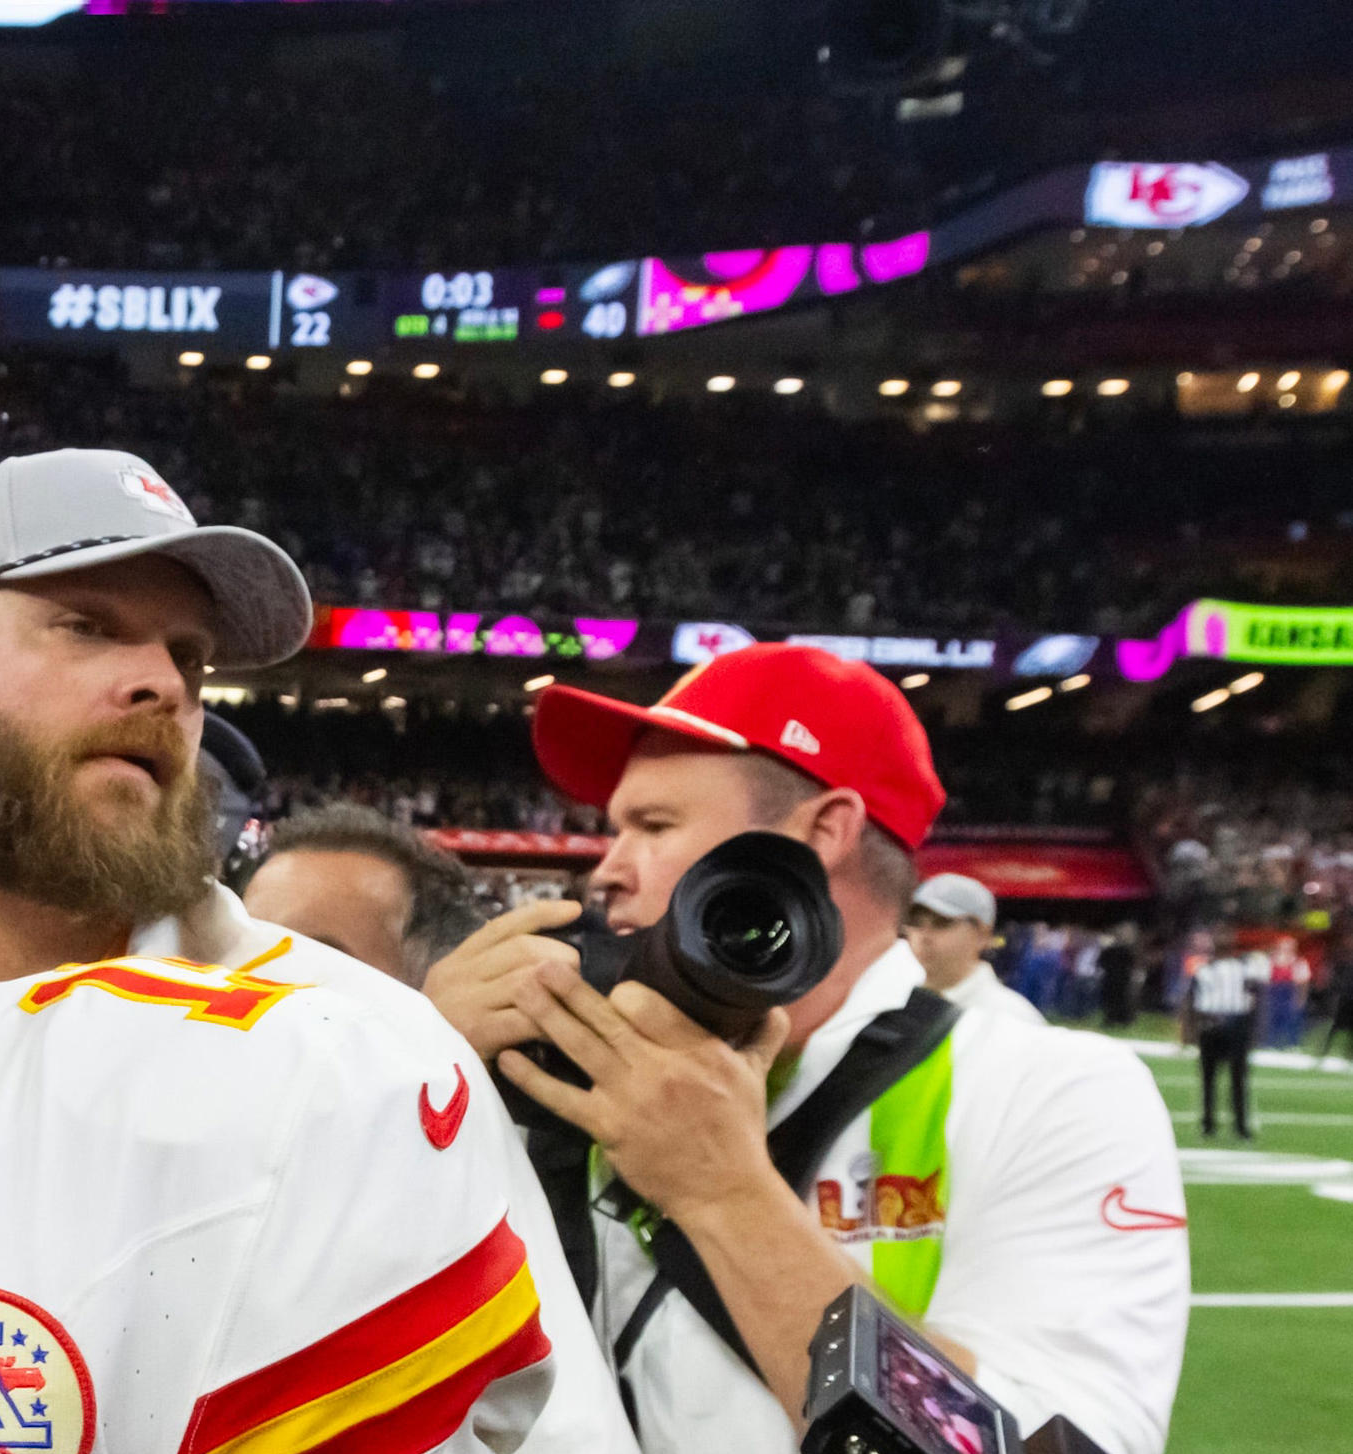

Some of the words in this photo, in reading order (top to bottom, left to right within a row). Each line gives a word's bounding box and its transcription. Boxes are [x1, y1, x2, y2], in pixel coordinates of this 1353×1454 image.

[49, 283, 222, 332] #SBLIX
[421, 271, 494, 310] 0:03
[291, 311, 331, 347] 22
[582, 301, 627, 338] 40
